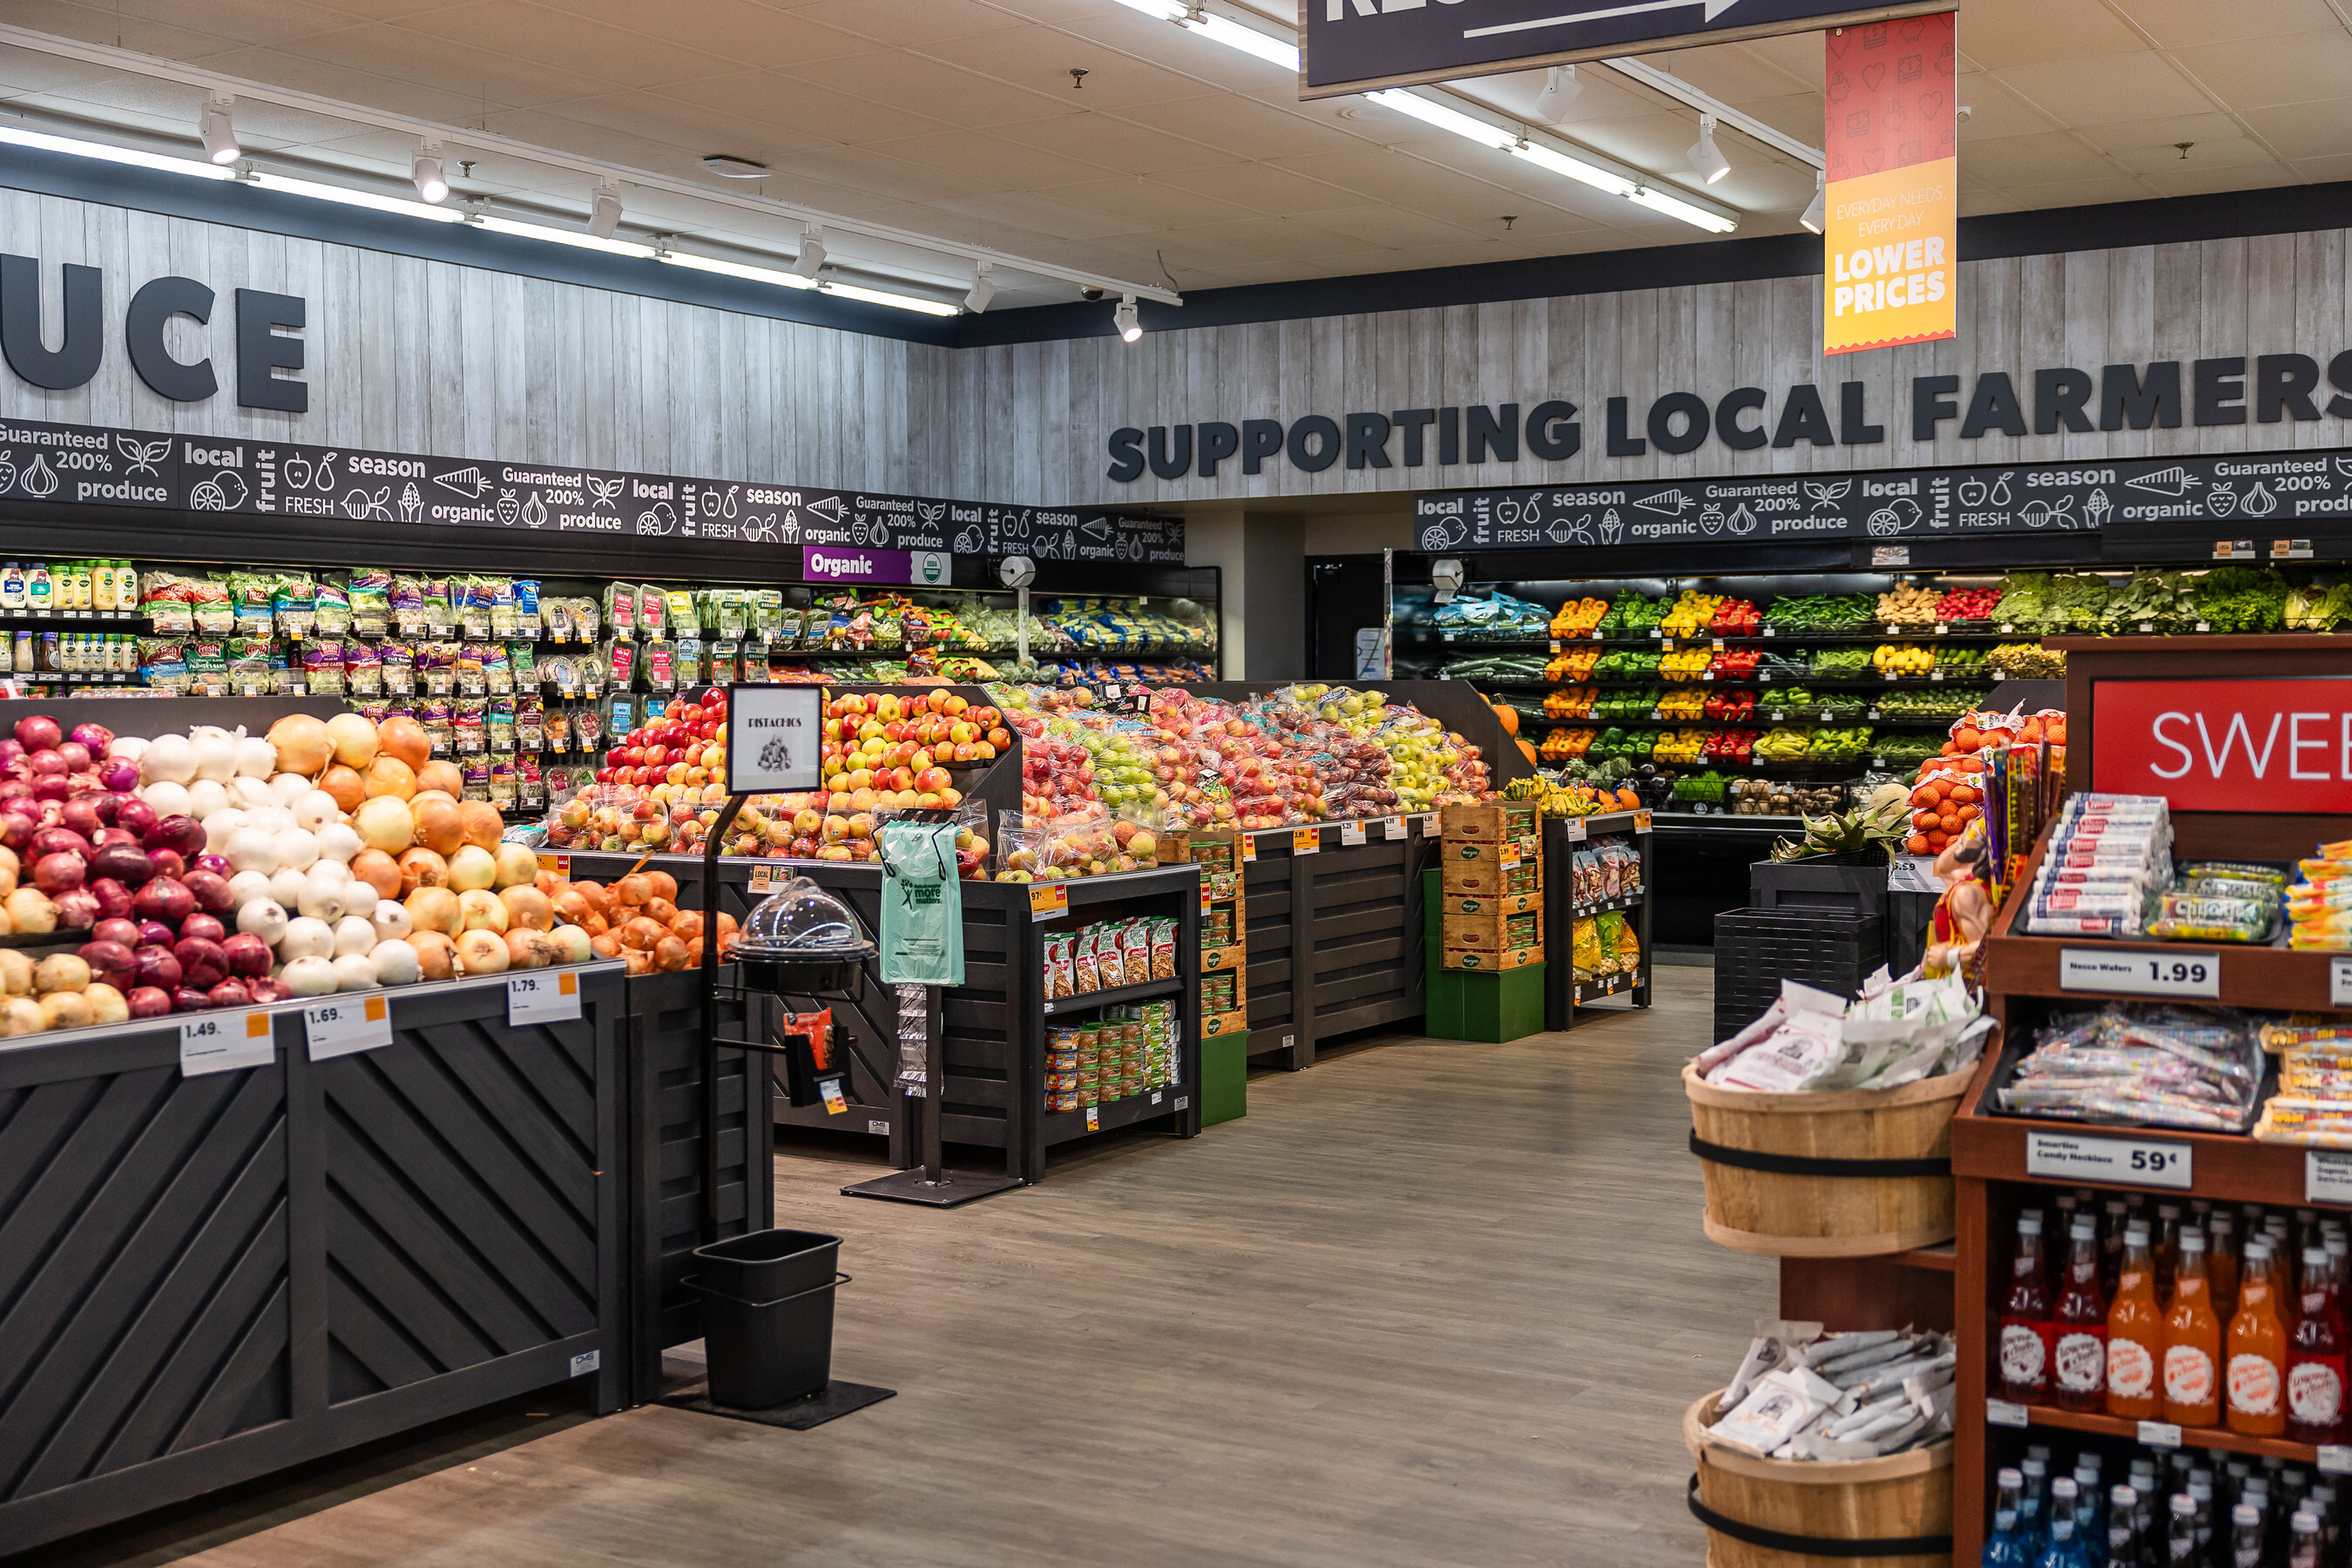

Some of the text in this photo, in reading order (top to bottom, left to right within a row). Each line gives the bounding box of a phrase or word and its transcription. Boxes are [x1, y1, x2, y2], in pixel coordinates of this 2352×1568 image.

[1836, 185, 1946, 220] EVERYDAY NEEDS,
[1858, 211, 1924, 238] EVERY DAY
[1835, 236, 1945, 283] LOWER
[1835, 270, 1945, 317] PRICES
[0, 254, 309, 413] UCE
[1106, 399, 1582, 483] SUPPORTING
[1606, 380, 1884, 458] LOCAL
[56, 450, 113, 472] 200%
[185, 442, 243, 468] local
[348, 456, 426, 478] season
[2214, 457, 2328, 476] Guaranteed
[255, 449, 276, 512] fruit
[503, 467, 582, 488] Guaranteed
[1862, 477, 1918, 497] local
[2026, 469, 2116, 487] season
[2274, 475, 2331, 491] 200%
[78, 480, 168, 502] produce
[545, 489, 585, 506] 200%
[633, 479, 673, 500] local
[747, 488, 801, 506] season
[1552, 490, 1625, 507] season
[1706, 481, 1798, 498] Guaranteed
[285, 497, 335, 516] FRESH
[431, 501, 495, 524] organic
[681, 483, 696, 537] fruit
[856, 496, 914, 512] Guaranteed
[1417, 497, 1463, 516] local
[1754, 497, 1801, 512] 200%
[1930, 477, 1950, 529] fruit
[2122, 500, 2203, 522] organic
[2295, 494, 2352, 517] prod
[560, 512, 622, 530] produce
[887, 514, 916, 528] 200%
[951, 505, 982, 523] local
[1036, 510, 1078, 527] season
[1472, 497, 1490, 544] fruit
[1959, 511, 2011, 527] FRESH
[702, 523, 737, 538] FRESH
[987, 509, 999, 553] fruit
[1119, 517, 1163, 531] Guaranteed
[1631, 519, 1697, 538] organic
[1771, 515, 1848, 534] produce
[805, 526, 851, 544] organic
[897, 533, 943, 549] produce
[1142, 532, 1164, 544] 200%
[1497, 529, 1539, 543] FRESH
[1003, 542, 1029, 555] FRESH
[1079, 544, 1115, 559] organic
[1150, 548, 1185, 562] produce
[811, 553, 873, 578] Organic
[748, 717, 802, 728] PISTACHIOS
[2150, 711, 2352, 780] SWE
[915, 888, 941, 897] more
[2149, 961, 2207, 983] 1.99
[511, 979, 536, 992] 1.79
[309, 1008, 338, 1024] 1.69
[185, 1021, 216, 1038] 1.49
